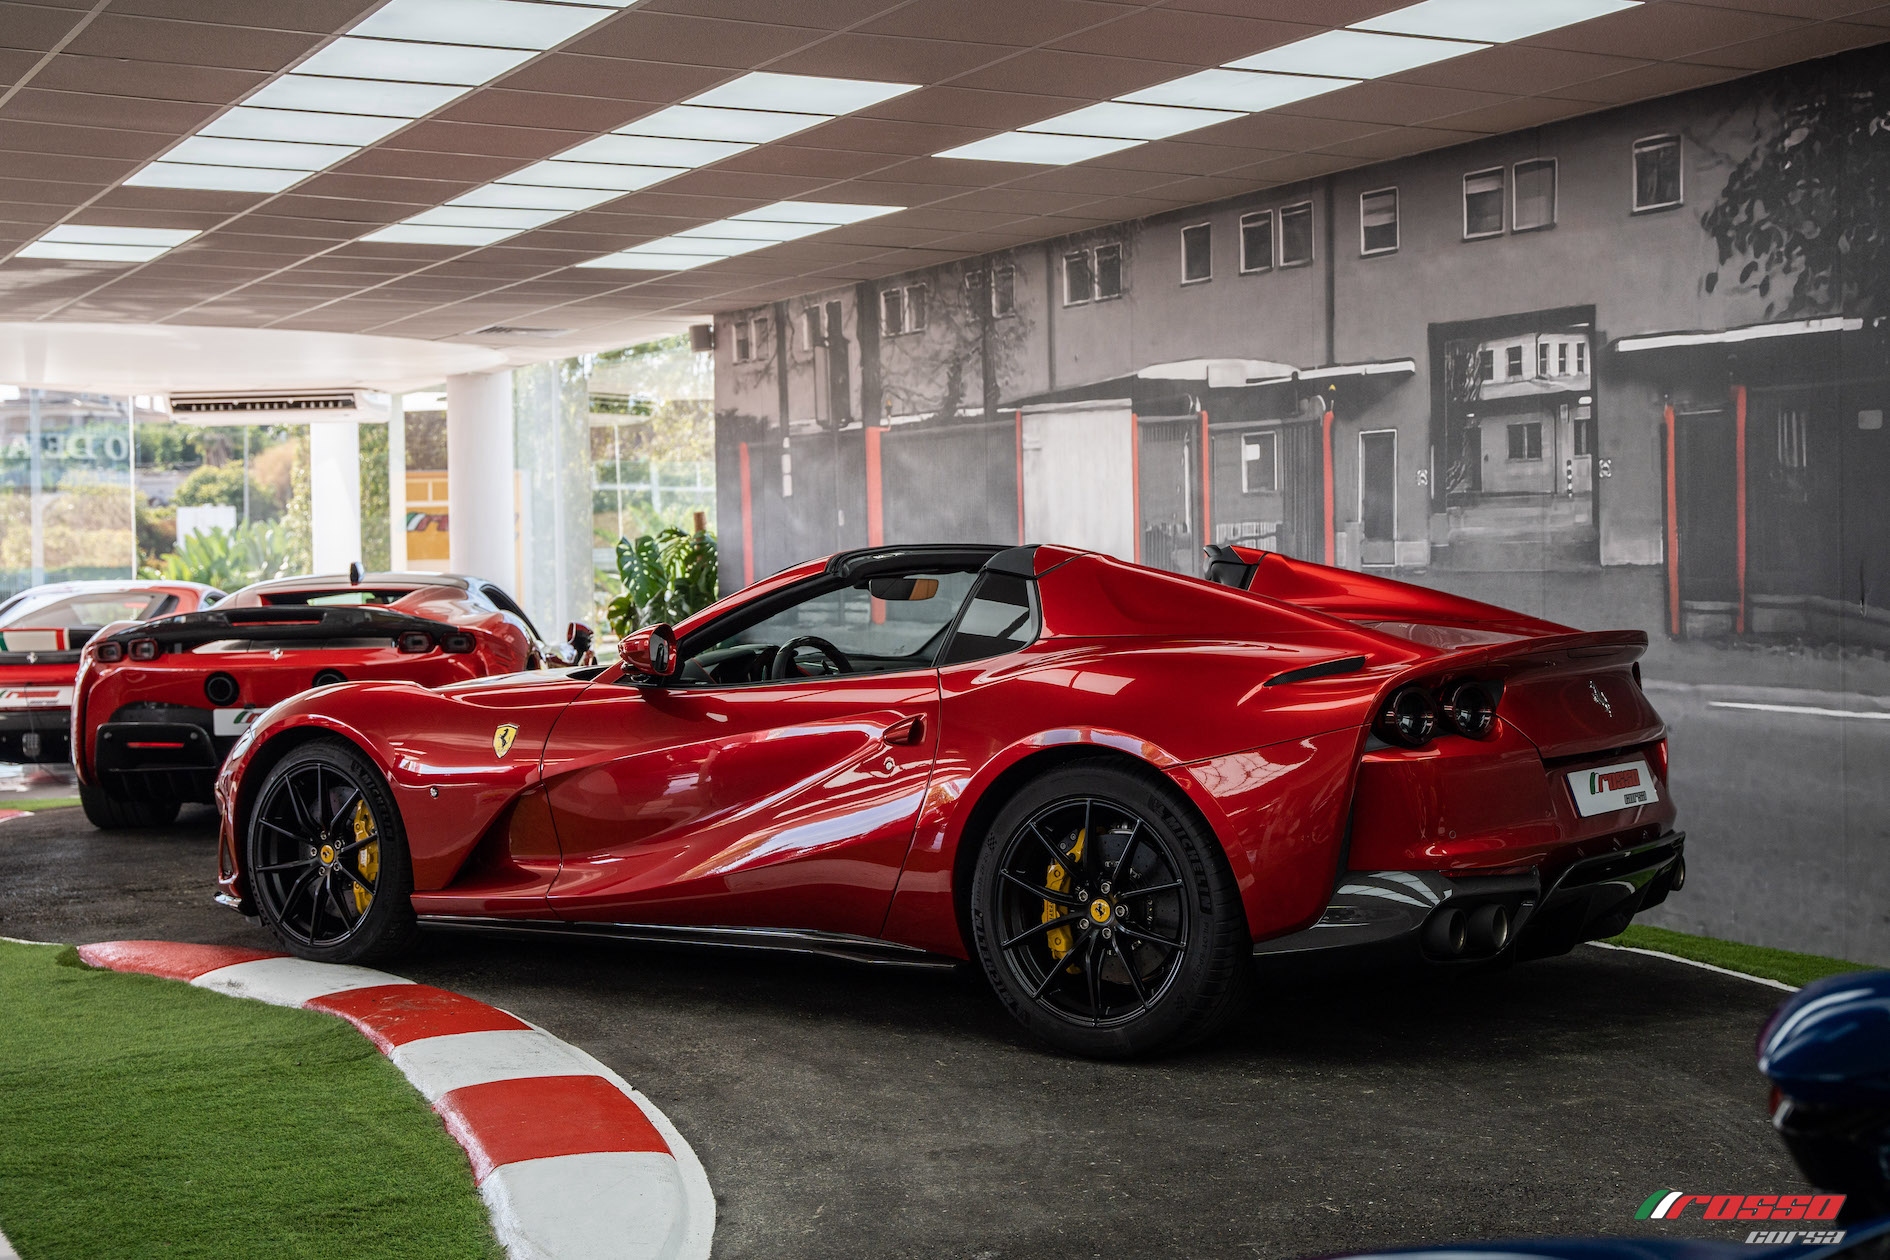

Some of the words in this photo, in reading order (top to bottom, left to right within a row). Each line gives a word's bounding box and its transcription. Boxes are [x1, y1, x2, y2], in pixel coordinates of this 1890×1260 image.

[1598, 769, 1640, 792] rosso
[1624, 791, 1647, 804] corsa
[1164, 810, 1211, 910] MICHELIN
[975, 915, 1016, 1008] MICHELIN
